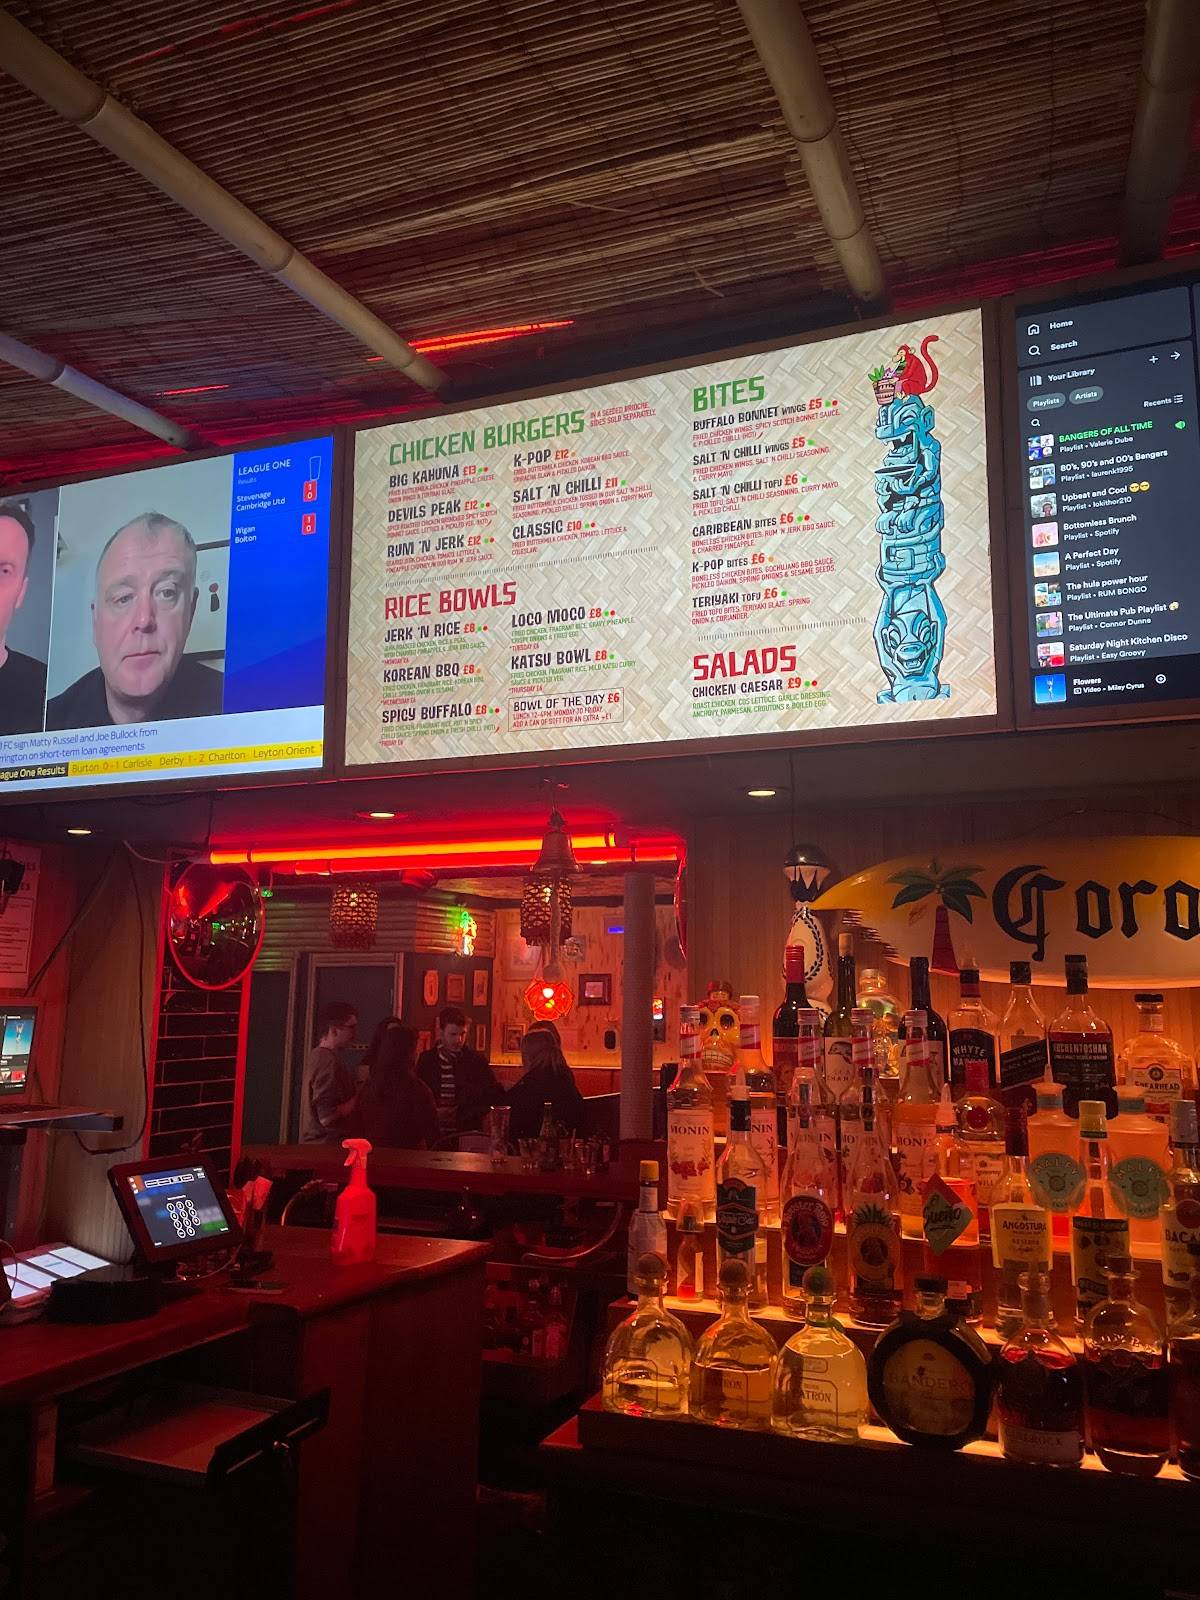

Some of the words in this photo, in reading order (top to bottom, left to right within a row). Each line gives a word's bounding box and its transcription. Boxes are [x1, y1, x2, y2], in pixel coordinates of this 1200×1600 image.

[1050, 319, 1073, 330] Home
[1051, 340, 1077, 350] Search
[1048, 373, 1066, 382] Your
[1067, 369, 1095, 379] Library
[694, 376, 764, 412] BITES
[1033, 398, 1059, 407] Playlists
[1075, 391, 1097, 400] Artists
[1144, 397, 1171, 407] Recents
[693, 415, 734, 431] BUFFALO
[739, 406, 779, 422] BONNET
[782, 404, 806, 414] WINGS
[809, 398, 822, 410] £5
[389, 431, 475, 465] CHICKEN
[483, 410, 584, 449] BURGERS
[1059, 431, 1098, 443] BANGERS
[1100, 429, 1112, 437] OF
[1114, 425, 1130, 434] ALL
[1131, 421, 1153, 430] TIME
[514, 449, 551, 466] K-POP
[555, 449, 569, 460] £12
[693, 452, 716, 465] SALT
[734, 445, 761, 459] CHILLI
[765, 443, 789, 453] WINGS
[792, 437, 805, 449] £5
[239, 463, 270, 476] LEAGUE
[272, 459, 291, 469] ONE
[1060, 462, 1080, 472] 80's,
[1081, 459, 1097, 468] 90's
[1099, 457, 1114, 465] and
[1116, 454, 1133, 463] 00's
[1135, 450, 1168, 461] Bangers
[389, 472, 408, 487] BIG
[412, 465, 459, 484] KAHUNA
[463, 465, 476, 476] £13
[237, 491, 271, 502] Stevenage
[513, 487, 542, 503] SALT
[566, 477, 602, 495] CHILLI
[605, 477, 618, 489] £11
[693, 487, 716, 500] SALT
[734, 480, 761, 494] CHILLI
[765, 480, 783, 488] TOFU
[784, 474, 798, 485] £6
[1062, 490, 1090, 502] Upbeat
[1092, 488, 1107, 497] and
[1108, 486, 1127, 494] Cool
[237, 501, 271, 511] Cambridge
[388, 505, 426, 522] DEVILS
[431, 500, 461, 515] PEAK
[464, 500, 478, 511] £12
[236, 526, 255, 534] Wigan
[512, 520, 563, 539] CLASSIC
[566, 521, 581, 531] £10
[693, 519, 752, 537] CARIBBEAN
[755, 518, 776, 528] BITES
[780, 513, 794, 524] £6
[1063, 520, 1106, 531] Bottomless
[1108, 514, 1136, 523] Brunch
[235, 535, 256, 544] Bolton
[387, 542, 414, 557] RUM
[435, 535, 464, 551] JERK
[468, 535, 482, 546] £12
[693, 559, 723, 573] K-POP
[727, 558, 748, 568] BITES
[752, 553, 765, 565] £6
[1073, 549, 1101, 559] Perfect
[1103, 548, 1119, 556] Day
[1066, 582, 1081, 590] The
[1083, 581, 1100, 589] hula
[1101, 577, 1127, 587] power
[1129, 575, 1148, 583] hour
[385, 593, 431, 619] RICE
[439, 581, 516, 613] BOWLS
[693, 592, 739, 608] TERIYAKI
[742, 592, 761, 602] TOFU
[764, 588, 777, 599] £6
[512, 612, 542, 628] LOCO
[547, 606, 585, 624] MOCO
[589, 608, 602, 618] £8
[1068, 613, 1083, 621] The
[1085, 609, 1118, 620] Ultimate
[1120, 607, 1136, 615] Pub
[1138, 604, 1166, 614] Playlist
[385, 629, 412, 642] JERK
[434, 622, 461, 637] RICE
[463, 623, 475, 633] £8
[1069, 642, 1104, 652] Saturday
[1106, 638, 1129, 648] Night
[1130, 635, 1162, 645] Kitchen
[1164, 633, 1187, 642] Disco
[511, 653, 552, 670] KATSU
[556, 649, 591, 664] BOWL
[595, 650, 607, 660] £8
[694, 645, 796, 680] SALADS
[384, 666, 430, 683] KOREAN
[436, 663, 459, 677] BBQ
[463, 665, 475, 675] £8
[693, 684, 736, 697] CHICKEN
[741, 679, 783, 693] CAESAR
[788, 677, 801, 688] £9
[1108, 684, 1125, 692] Miley
[1126, 682, 1144, 691] Cyrus
[514, 700, 541, 712] BOWL
[546, 698, 558, 709] OF
[562, 696, 581, 707] THE
[585, 694, 604, 706] DAY
[607, 693, 619, 702] £6
[382, 707, 415, 723] SPICY
[421, 703, 471, 720] BUFFALO
[475, 705, 487, 715] £8
[4, 741, 13, 750] FC
[14, 741, 29, 750] sign
[30, 738, 51, 747] Matty
[53, 736, 78, 745] Russell
[80, 734, 95, 742] and
[96, 733, 109, 742] Joe
[111, 729, 137, 740] Bullock
[139, 729, 157, 737] from
[40, 748, 79, 759] short-term
[99, 743, 144, 754] agreements
[160, 756, 184, 766] Derby
[208, 752, 245, 761] Charlton
[253, 748, 284, 758] Leyton
[286, 746, 314, 755] Orient
[20, 769, 35, 777] One
[37, 766, 65, 775] Results
[72, 764, 99, 772] Burton
[123, 760, 152, 768] Carlisle
[953, 1045, 986, 1057] WHYTE
[670, 1125, 709, 1135] MONIN
[1002, 1220, 1046, 1231] ANGOSTURA
